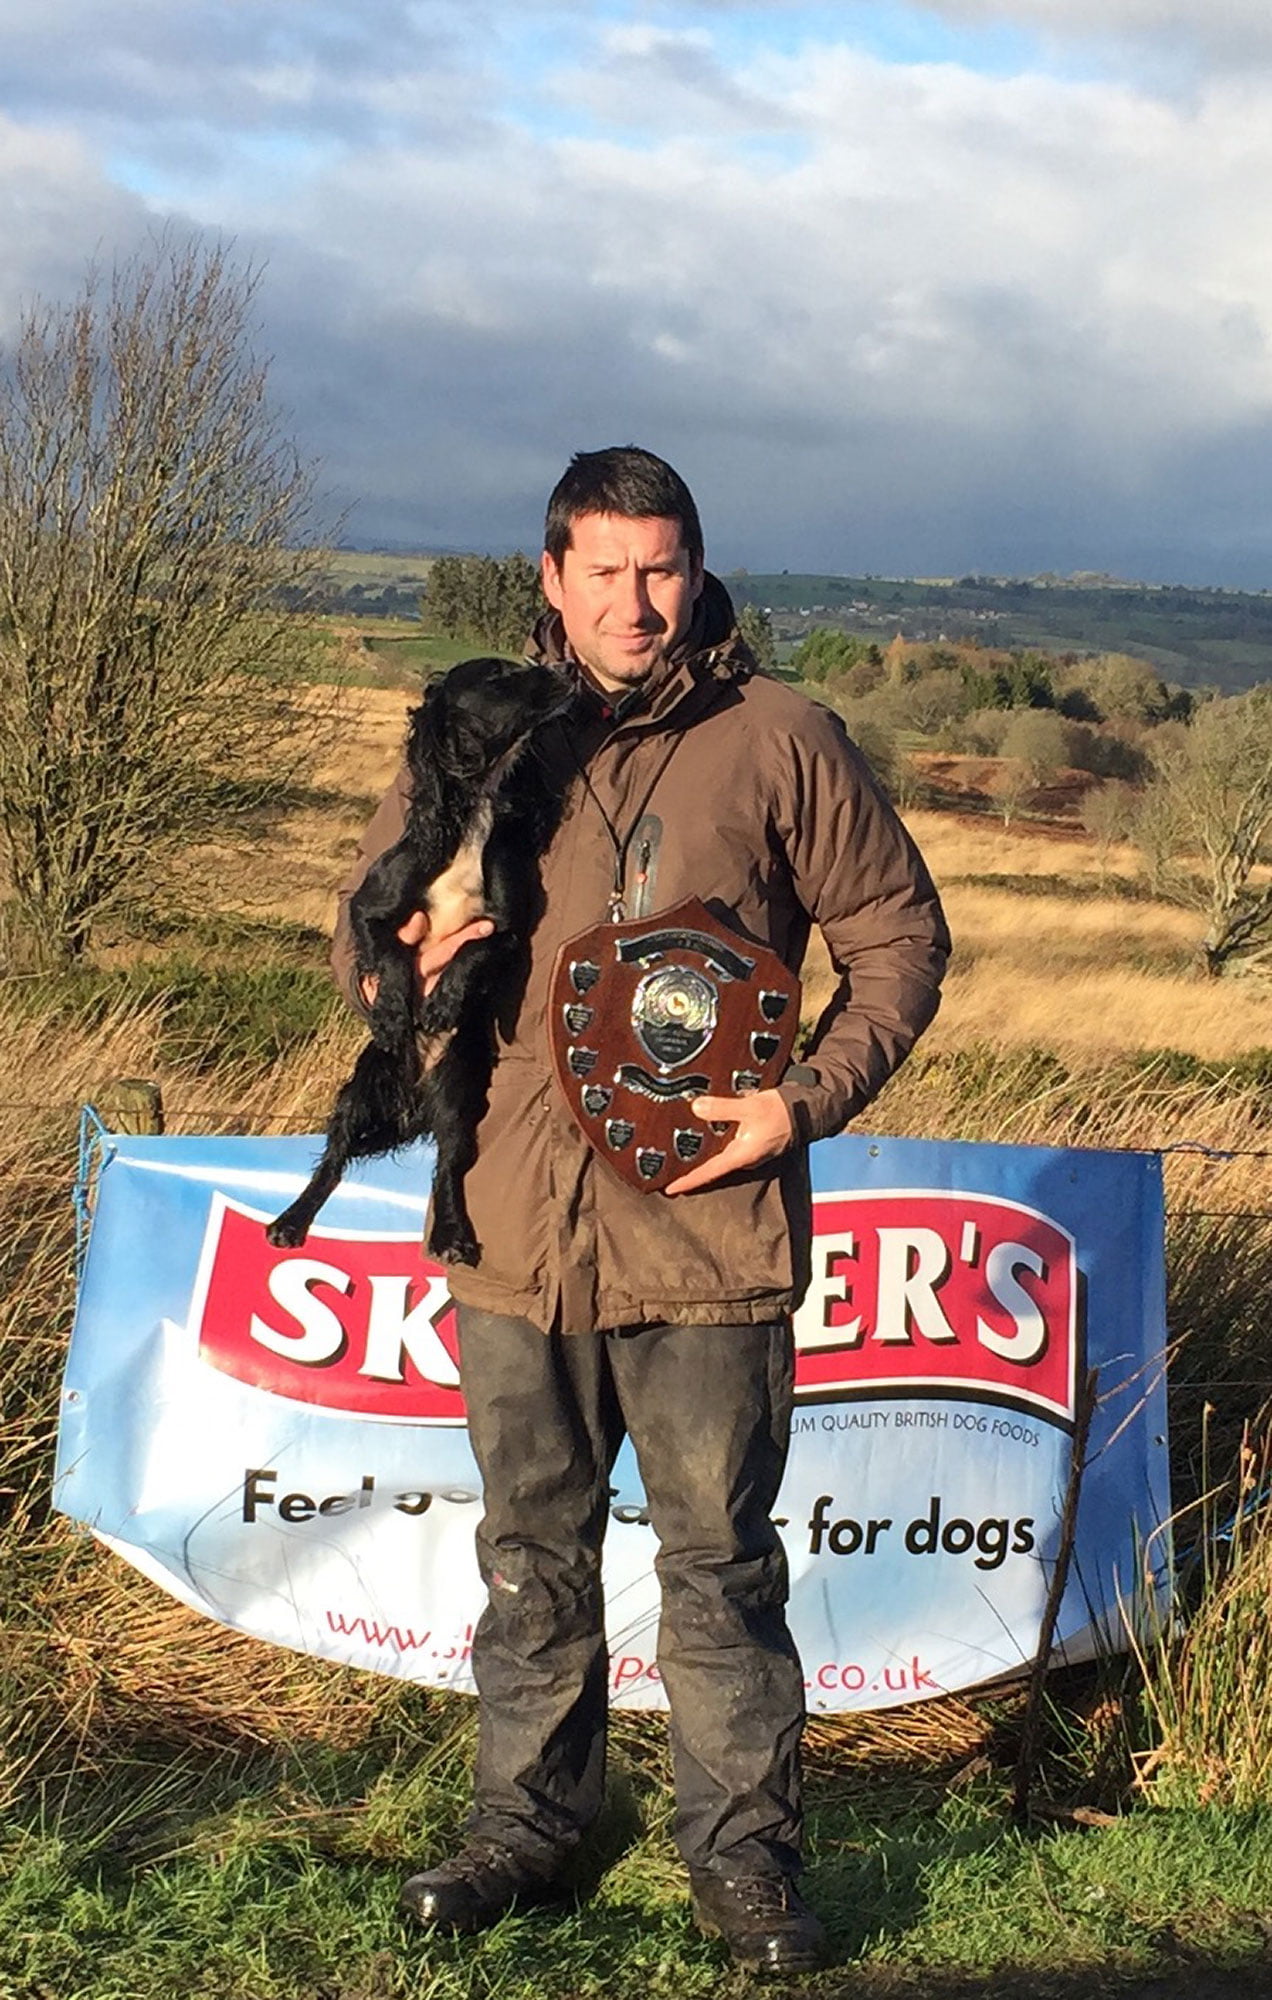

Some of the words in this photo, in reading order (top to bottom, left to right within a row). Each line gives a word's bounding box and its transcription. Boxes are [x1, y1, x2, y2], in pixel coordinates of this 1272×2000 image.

[250, 1221, 1048, 1387] SKER'S
[821, 1412, 890, 1432] QUALITY
[895, 1411, 948, 1428] BRITISH
[953, 1413, 988, 1433] DOG
[991, 1419, 1040, 1447] FOODS
[808, 1495, 893, 1555] for
[905, 1496, 1035, 1570] dogs
